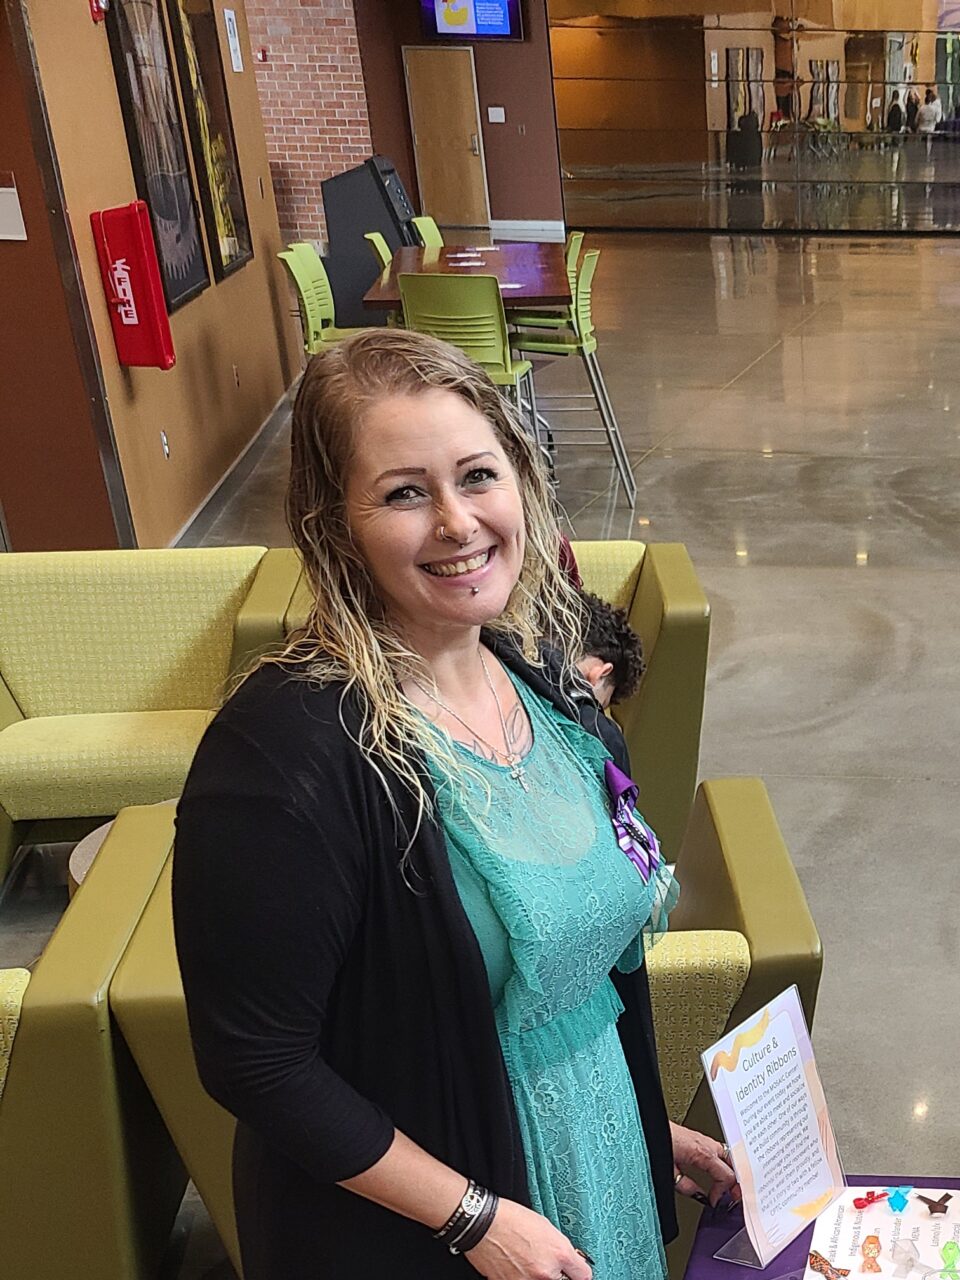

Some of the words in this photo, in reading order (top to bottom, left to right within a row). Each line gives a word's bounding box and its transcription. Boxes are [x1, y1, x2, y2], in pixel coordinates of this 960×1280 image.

[116, 277, 135, 319] FIRE
[735, 1071, 766, 1102] Identity
[765, 1046, 797, 1077] Ribbons
[742, 1043, 772, 1072] Culture
[771, 1036, 779, 1049] &
